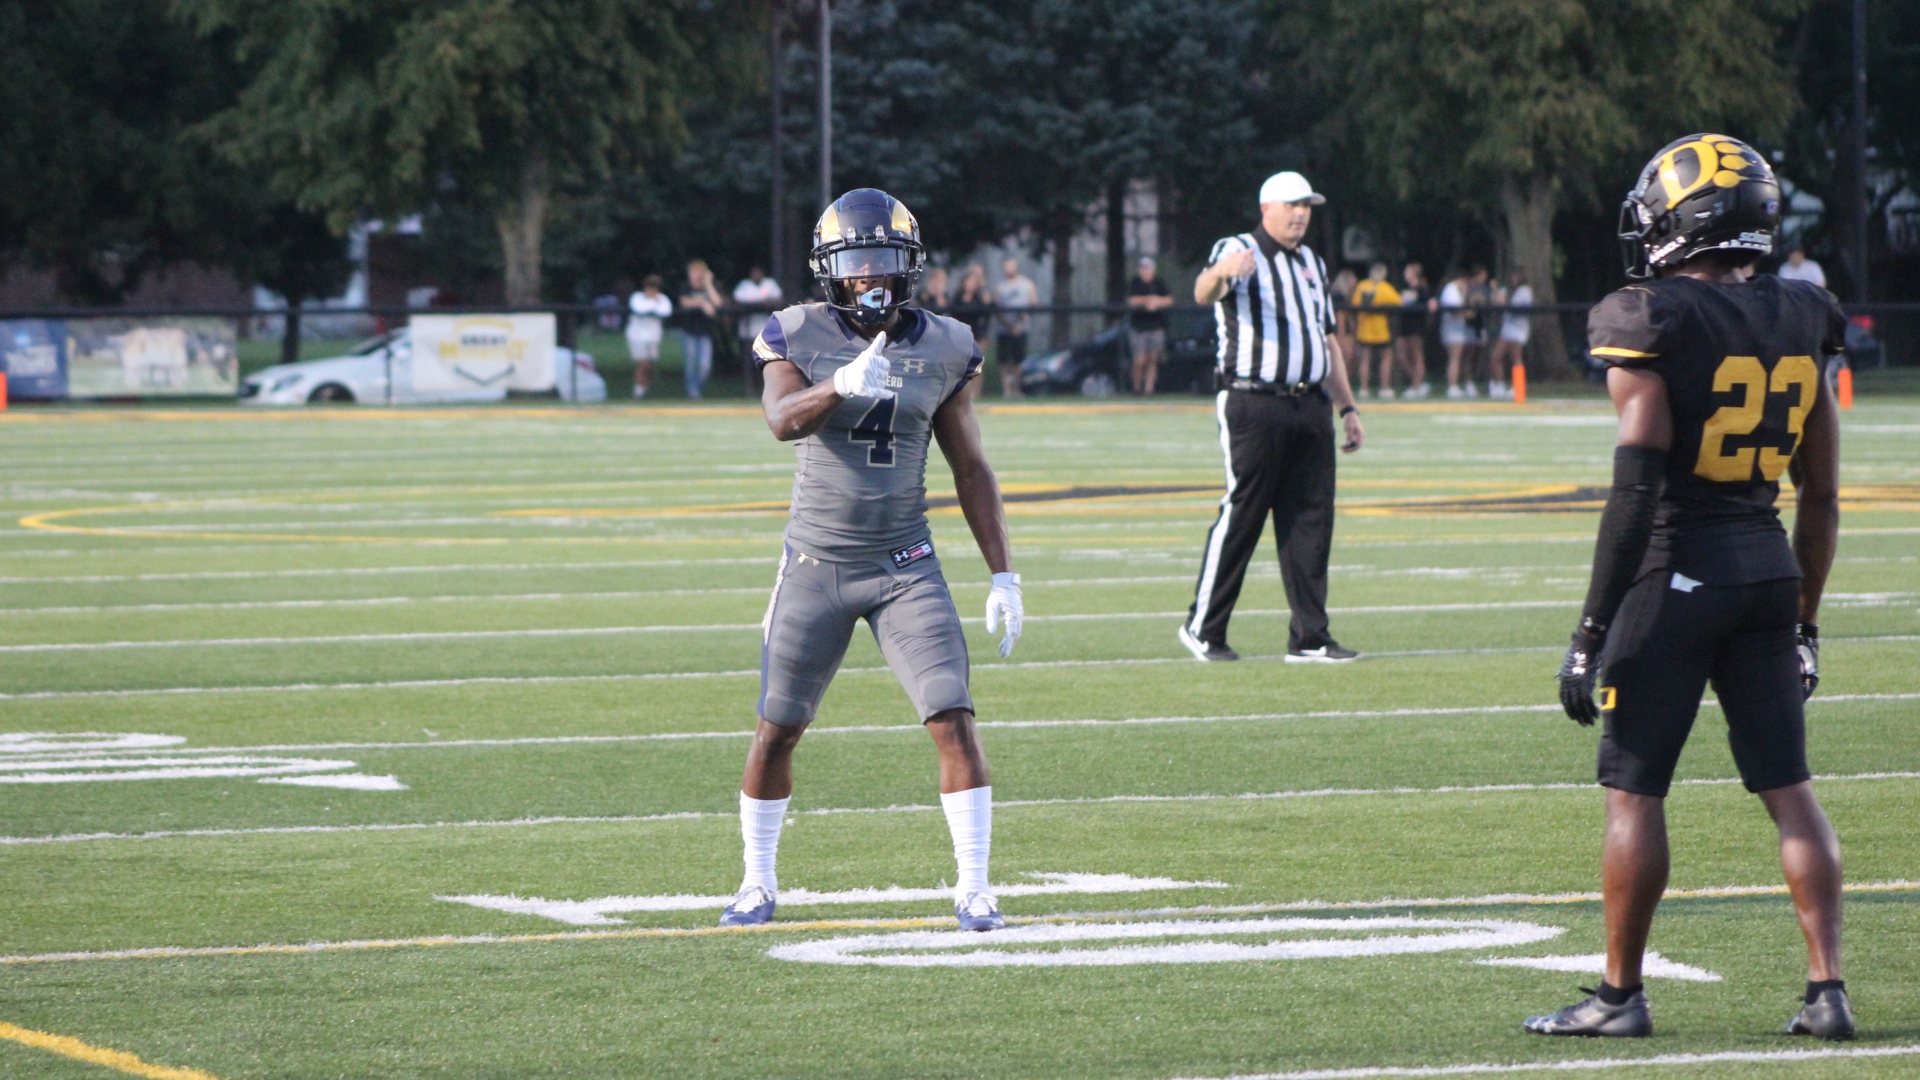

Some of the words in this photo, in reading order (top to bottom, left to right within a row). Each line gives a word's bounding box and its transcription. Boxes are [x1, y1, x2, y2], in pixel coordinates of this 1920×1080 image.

[884, 375, 903, 388] ERD
[1693, 355, 1819, 482] 23
[848, 391, 899, 467] 4
